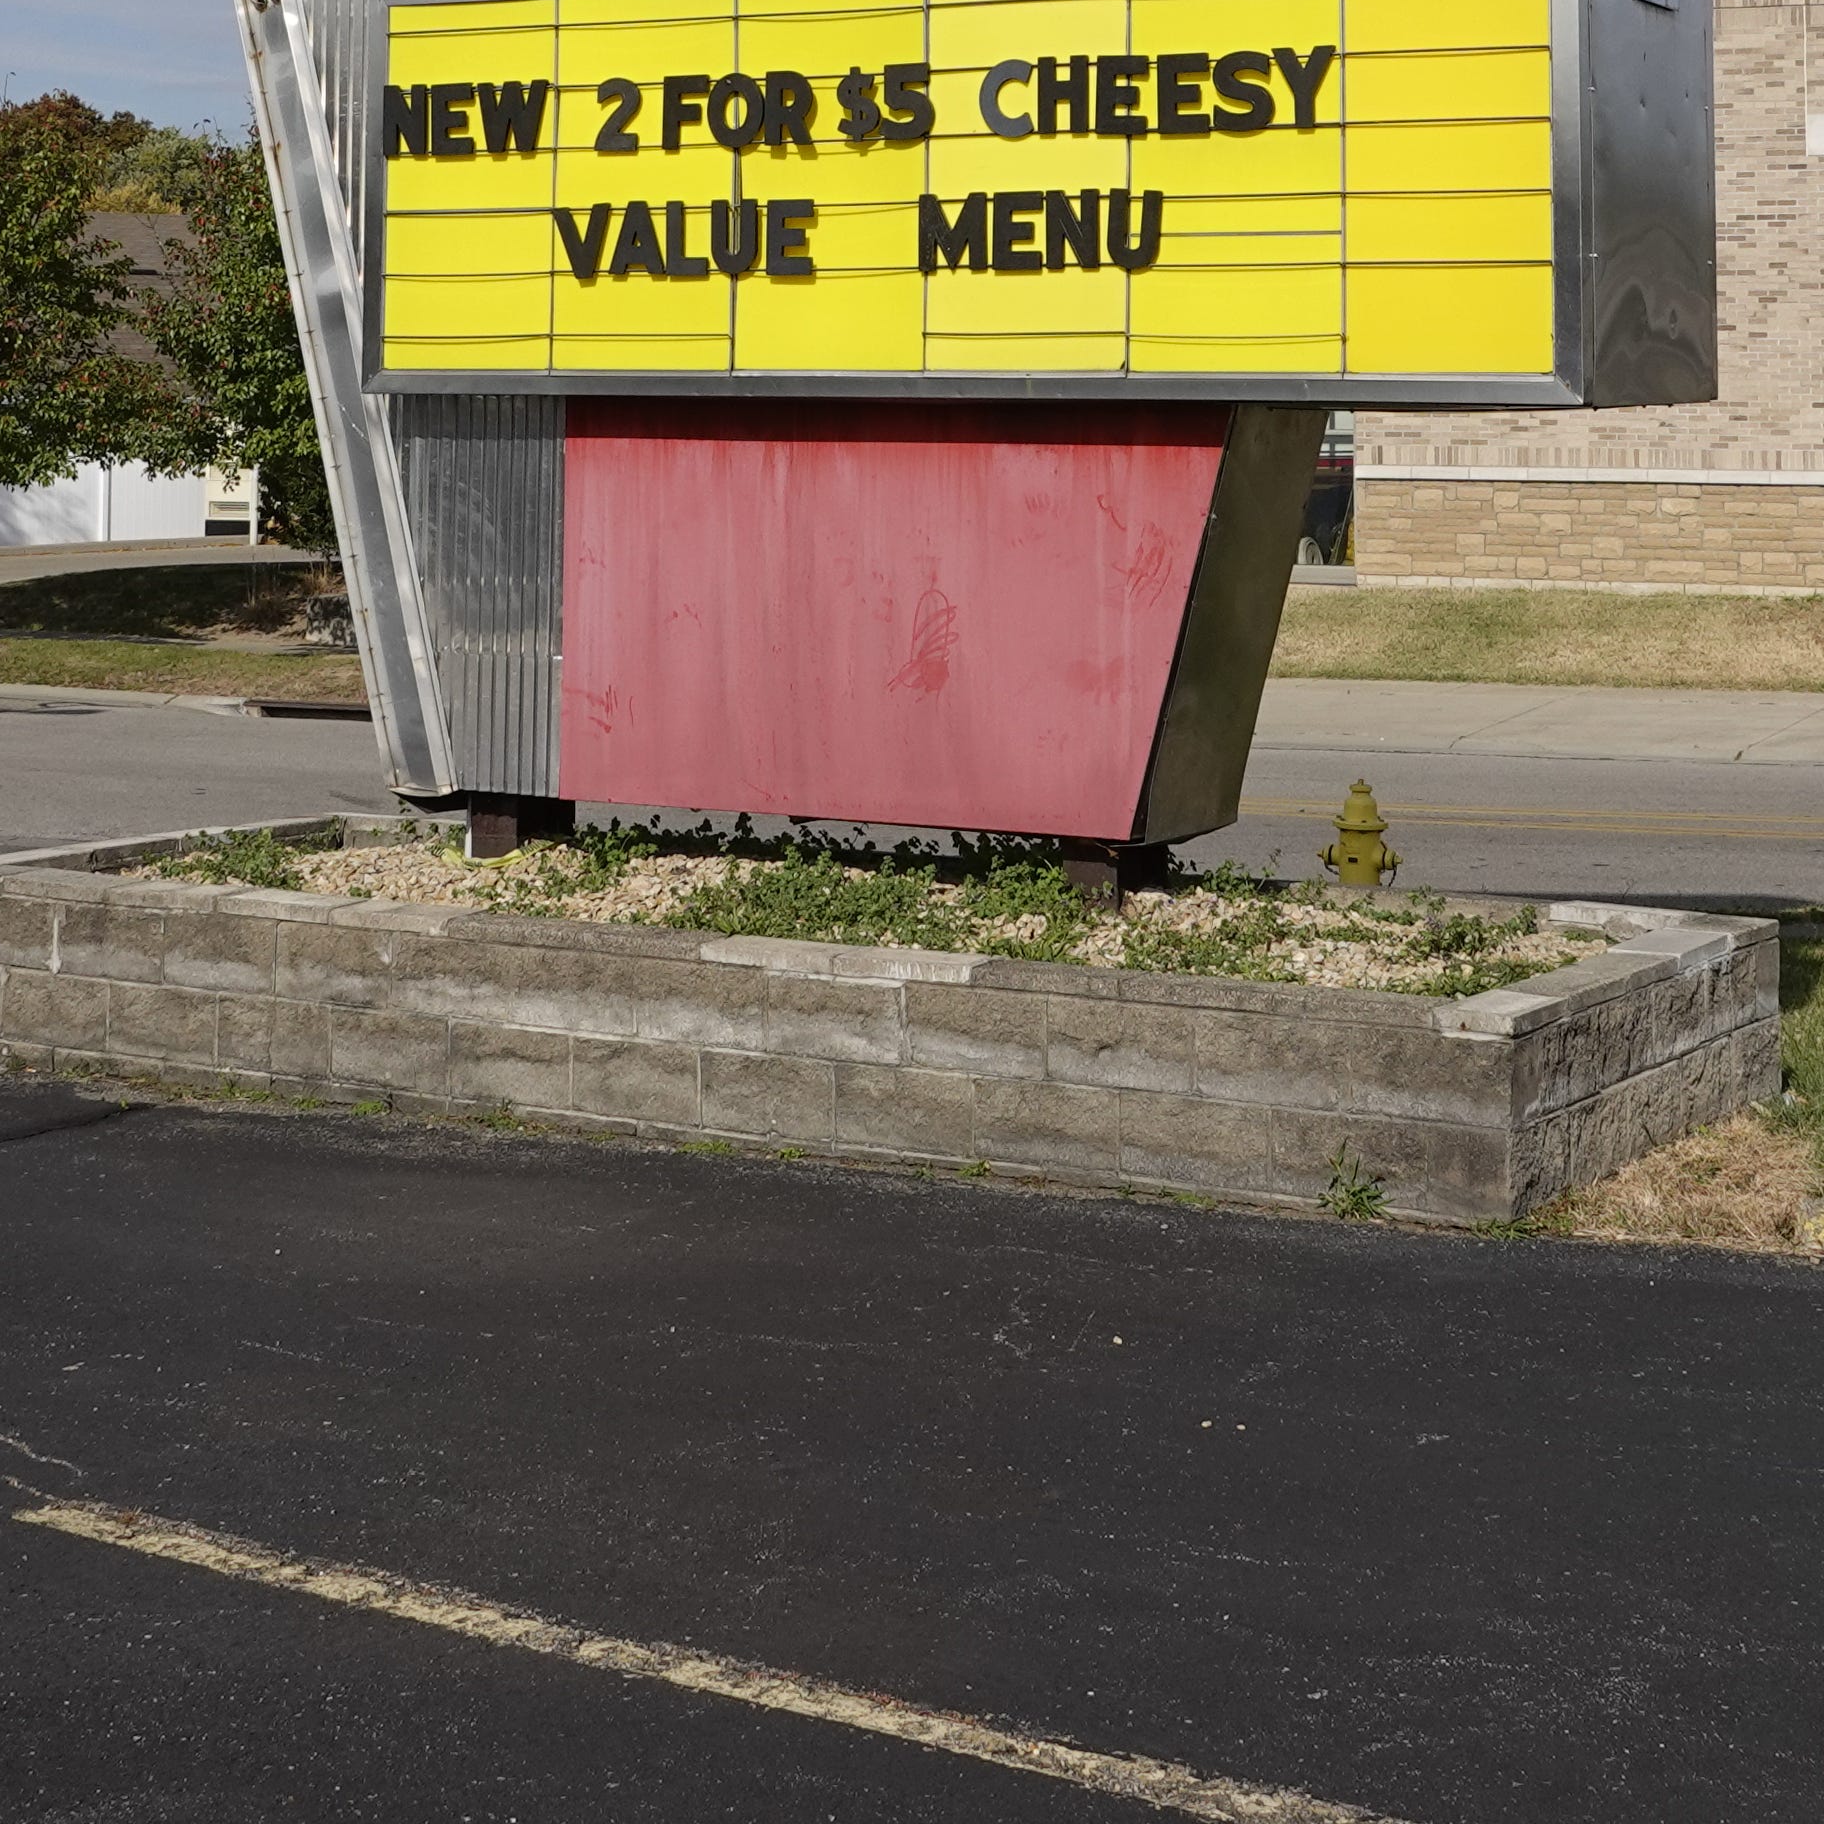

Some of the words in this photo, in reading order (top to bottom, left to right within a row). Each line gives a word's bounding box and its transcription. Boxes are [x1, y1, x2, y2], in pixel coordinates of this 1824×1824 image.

[383, 79, 547, 158] NEW
[596, 78, 641, 153] 2
[662, 70, 814, 150] FOR
[837, 61, 934, 143] $5
[980, 45, 1336, 138] CHEESY
[553, 198, 815, 280] VALUE
[918, 188, 1164, 274] MENU
